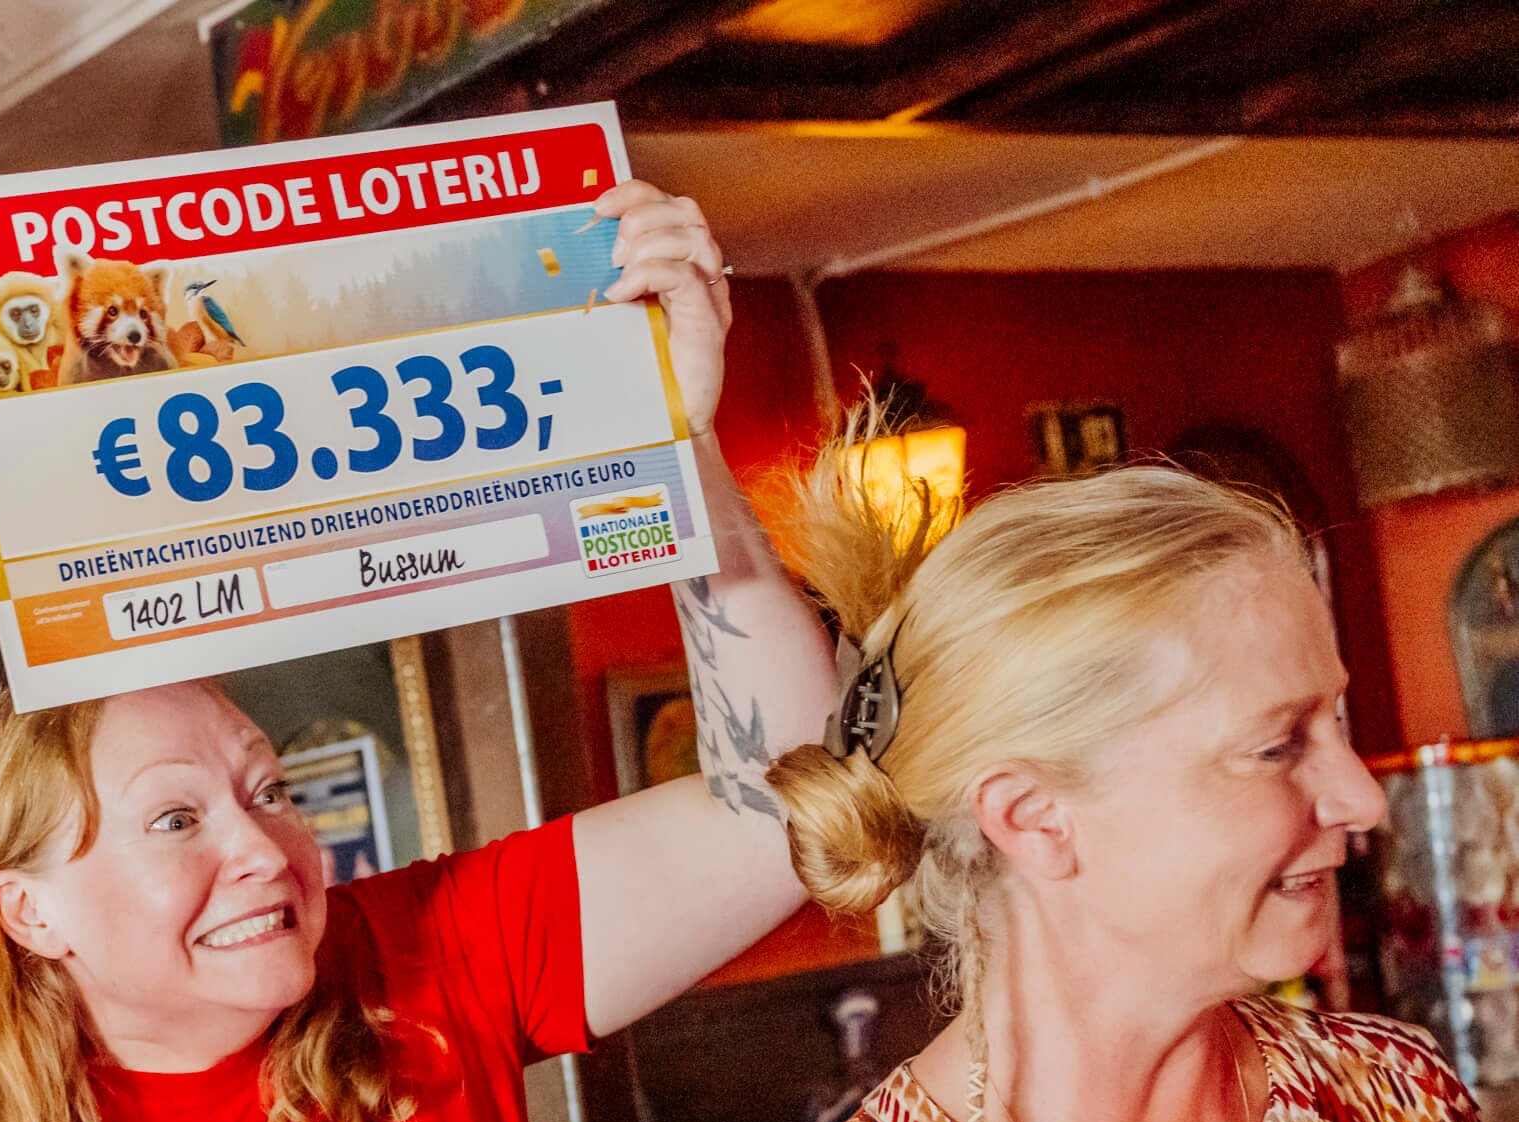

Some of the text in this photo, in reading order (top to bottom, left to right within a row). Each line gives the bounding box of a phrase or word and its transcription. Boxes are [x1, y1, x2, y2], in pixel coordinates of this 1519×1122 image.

[11, 148, 541, 262] POSTCODE LOTERIJ
[58, 460, 636, 582] DRIEËNTACHTIGDUIZEND DRIEHONDERDDRIEËNDERTIG EURO
[591, 512, 659, 536] NATIONALE
[583, 524, 674, 559] POSTCODE
[599, 546, 667, 570] LOTERIJ
[359, 548, 464, 588] Bussum
[122, 592, 186, 632] 1402
[196, 573, 244, 618] LM
